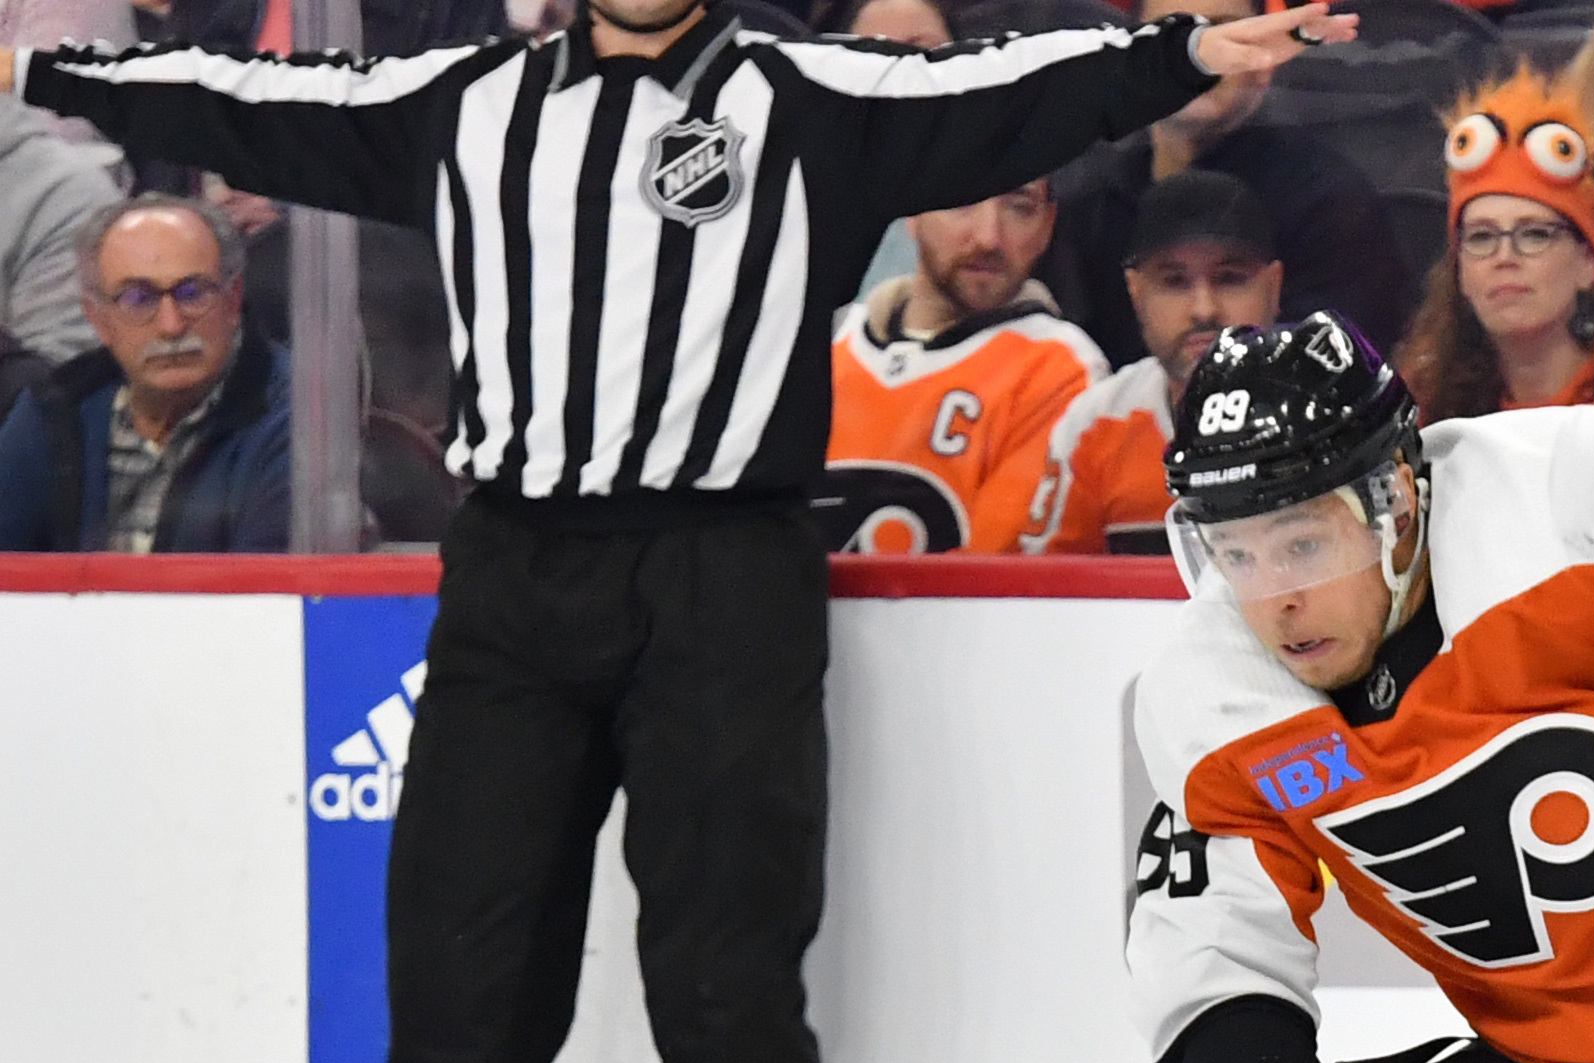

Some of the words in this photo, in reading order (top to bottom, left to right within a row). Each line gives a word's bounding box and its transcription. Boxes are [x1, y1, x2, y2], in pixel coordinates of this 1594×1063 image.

[664, 143, 725, 198] NHL
[931, 388, 982, 457] C
[1198, 389, 1251, 436] 89
[1189, 463, 1257, 488] BAUER
[1255, 742, 1366, 813] IBX
